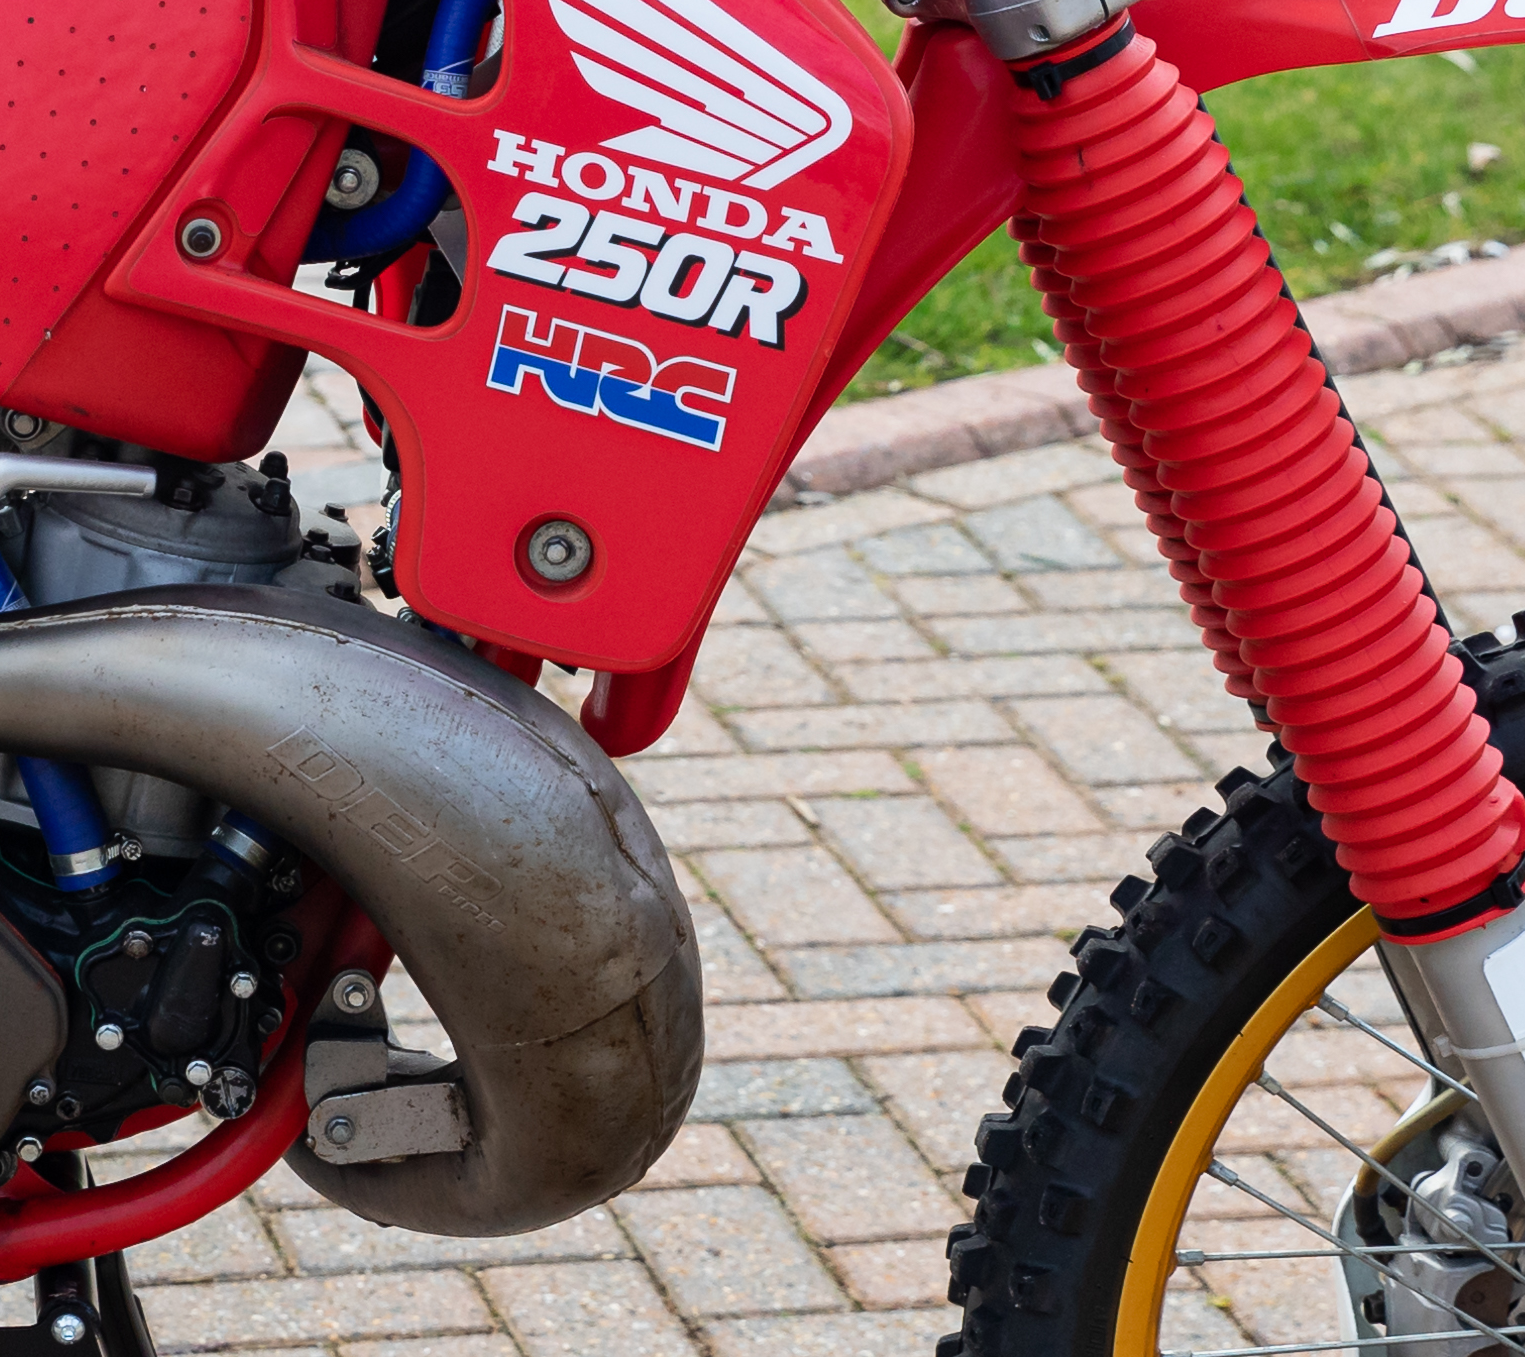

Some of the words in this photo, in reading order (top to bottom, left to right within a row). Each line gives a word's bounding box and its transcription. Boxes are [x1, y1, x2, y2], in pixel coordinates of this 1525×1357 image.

[486, 128, 844, 264] HONDA
[486, 191, 808, 350] 250R
[484, 303, 738, 453] HRC
